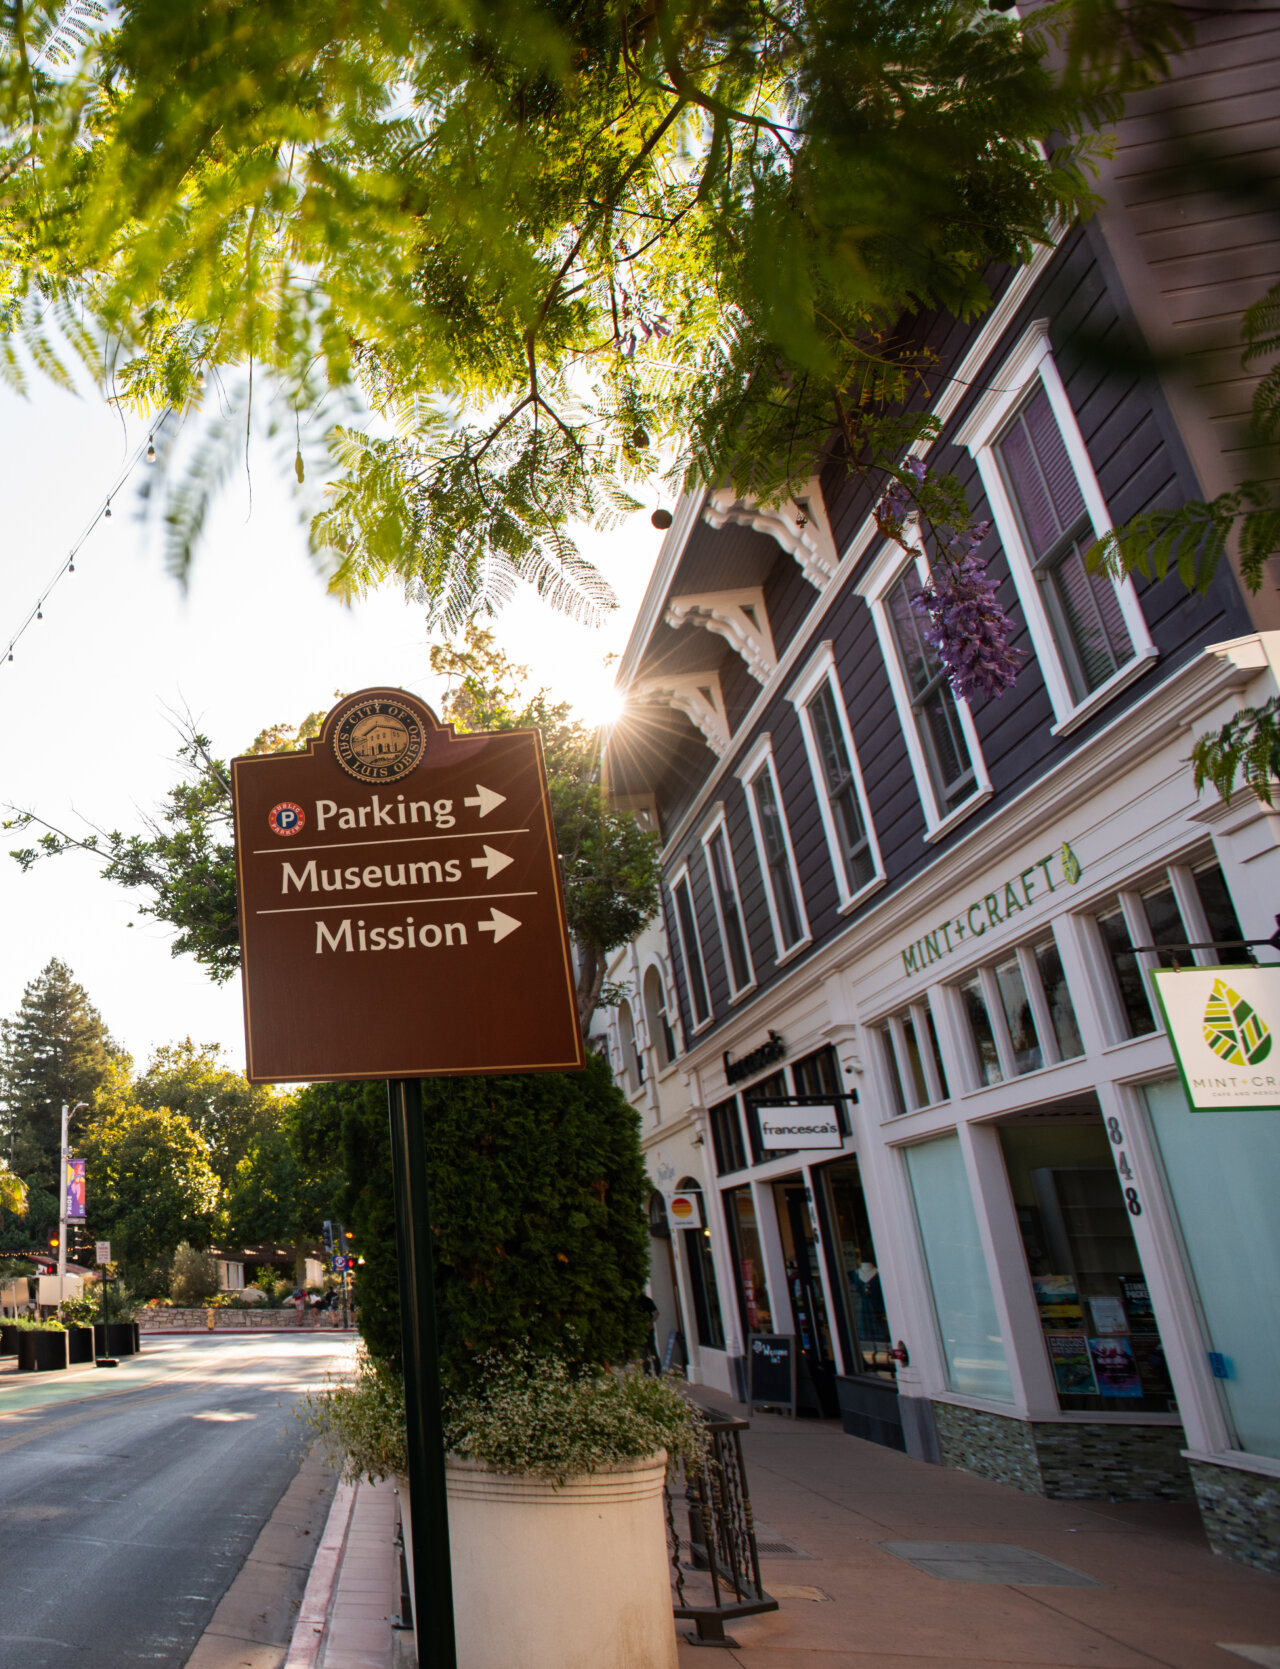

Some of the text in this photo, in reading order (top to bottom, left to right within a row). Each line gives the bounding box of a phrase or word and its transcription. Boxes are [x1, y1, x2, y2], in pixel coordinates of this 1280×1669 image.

[349, 704, 407, 724] CITY OF
[339, 725, 420, 777] SAN LUIS OBISPO
[272, 803, 300, 814] PUBLIC
[281, 811, 295, 828] P
[316, 794, 456, 832] Parking
[271, 820, 303, 835] PARKING
[281, 859, 462, 894] Museums
[315, 917, 468, 954] Mission
[762, 1121, 837, 1135] francesca's
[1107, 1116, 1142, 1216] 848
